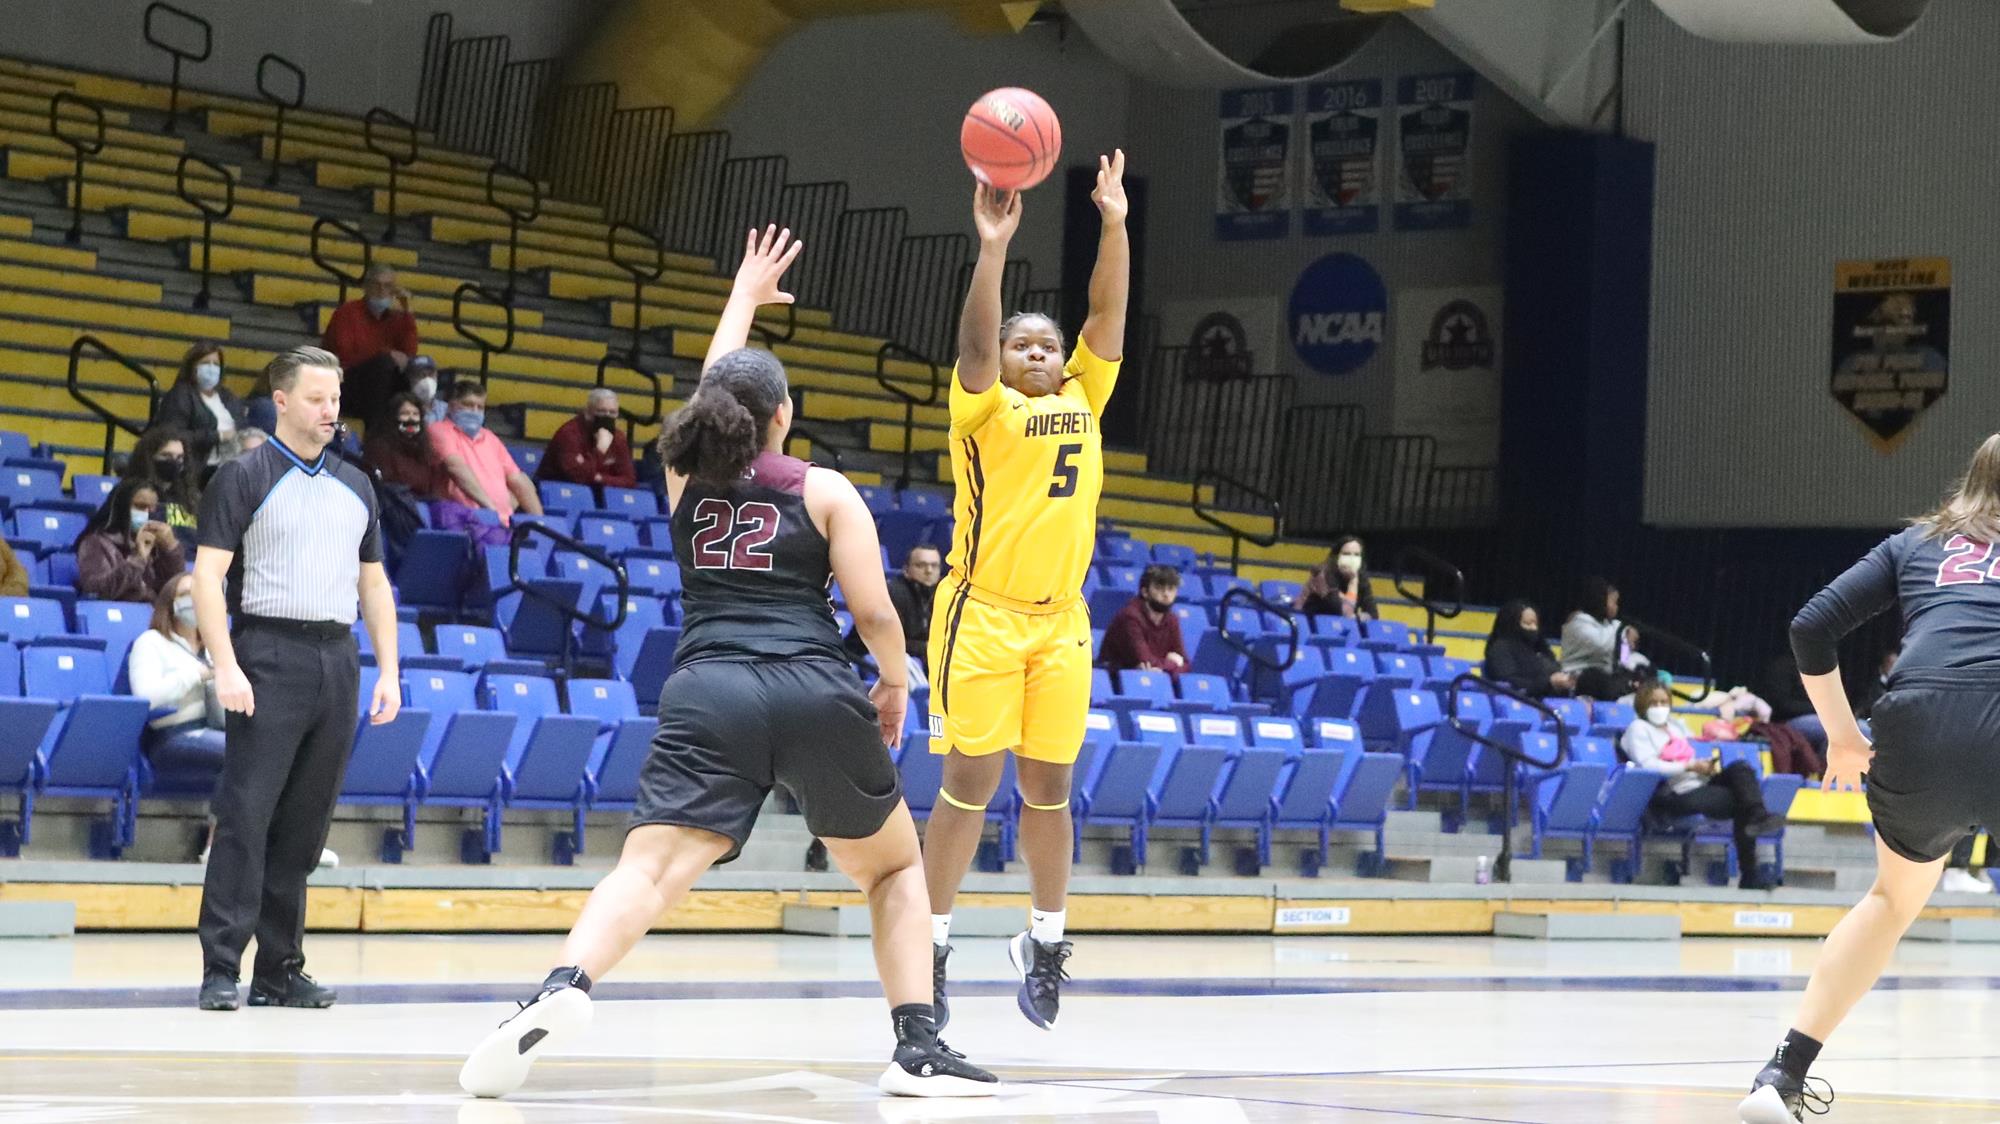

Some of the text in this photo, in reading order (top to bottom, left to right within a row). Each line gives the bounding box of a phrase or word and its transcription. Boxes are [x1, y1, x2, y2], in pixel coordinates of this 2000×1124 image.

[1324, 86, 1366, 110] 2016
[1296, 311, 1384, 345] NCAA
[1048, 443, 1083, 498] 5
[692, 498, 781, 571] 22
[1935, 533, 2000, 588] 2
[1282, 910, 1332, 922] SECTION
[1739, 914, 1778, 923] SECTION
